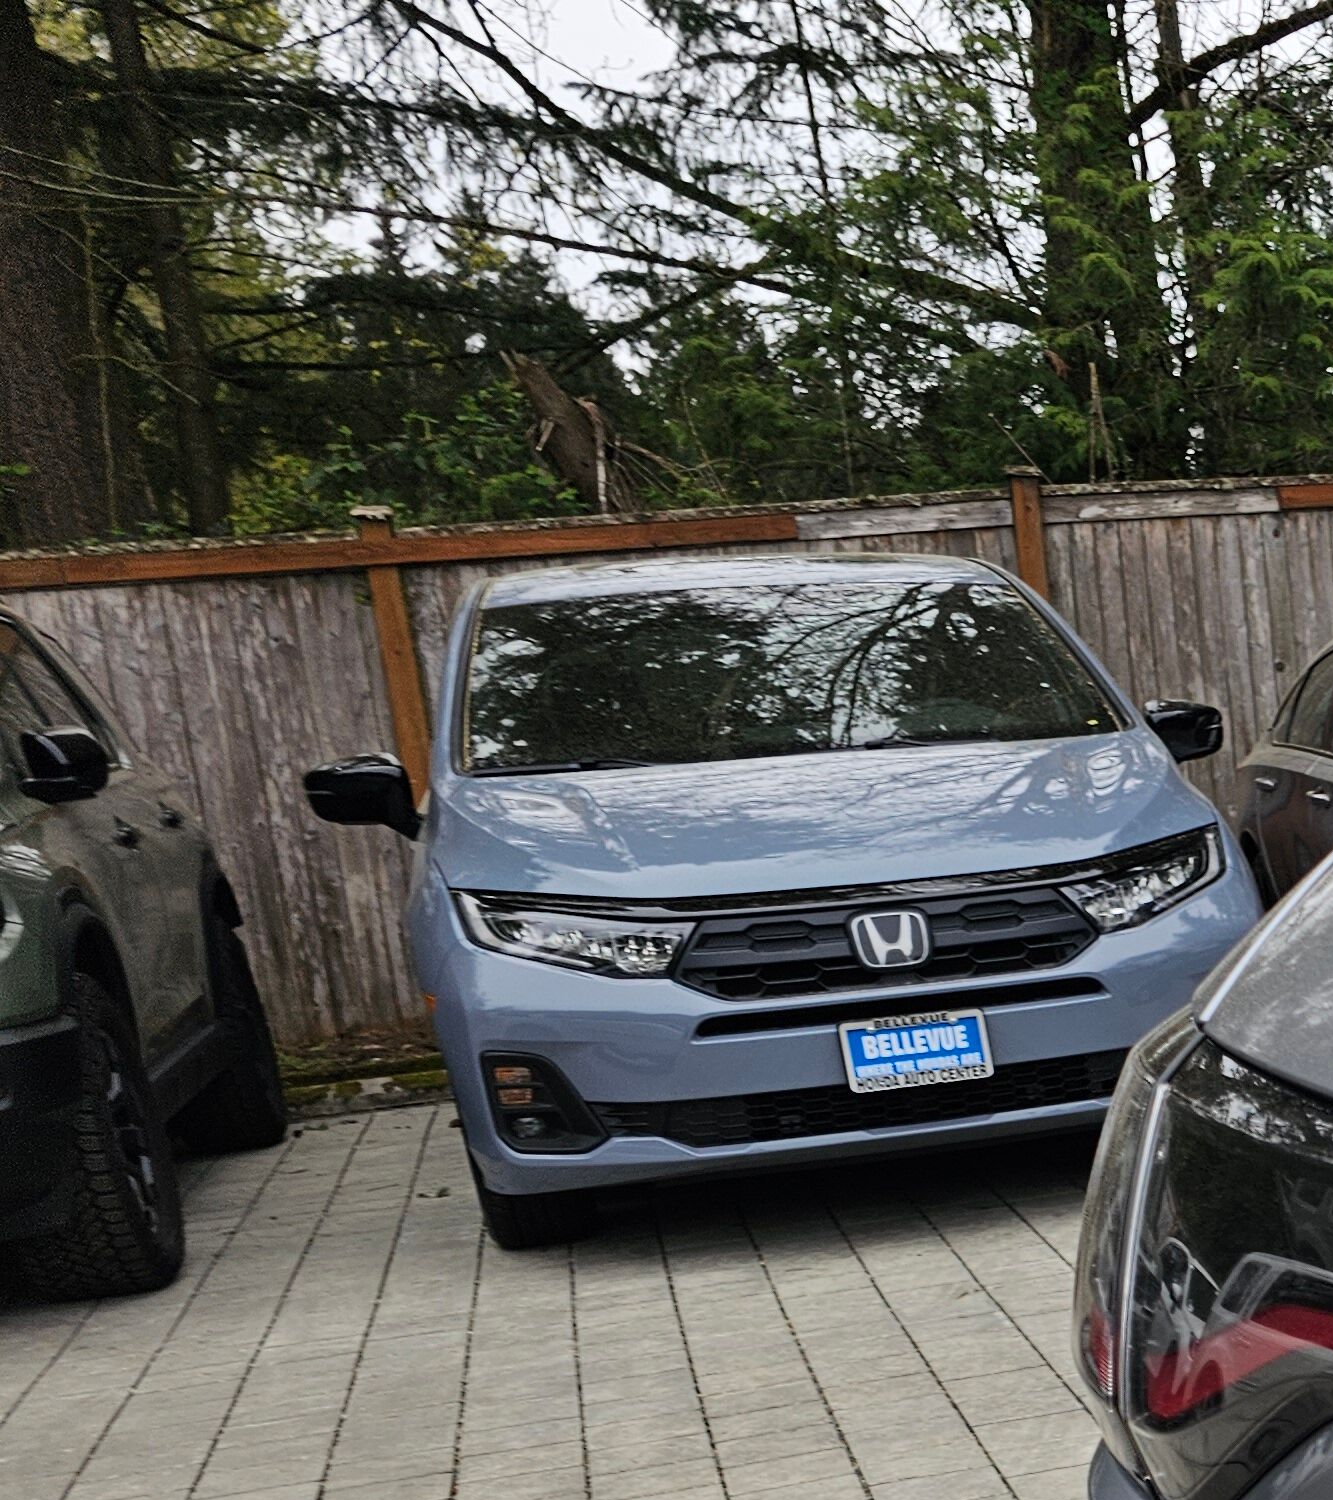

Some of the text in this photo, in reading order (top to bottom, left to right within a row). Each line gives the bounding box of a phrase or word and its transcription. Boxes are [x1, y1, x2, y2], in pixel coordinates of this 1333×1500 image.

[873, 1012, 950, 1029] BELLEVUE
[861, 1025, 970, 1060] BELLEVUE
[904, 1069, 936, 1086] AUTO
[940, 1064, 988, 1081] CENTER
